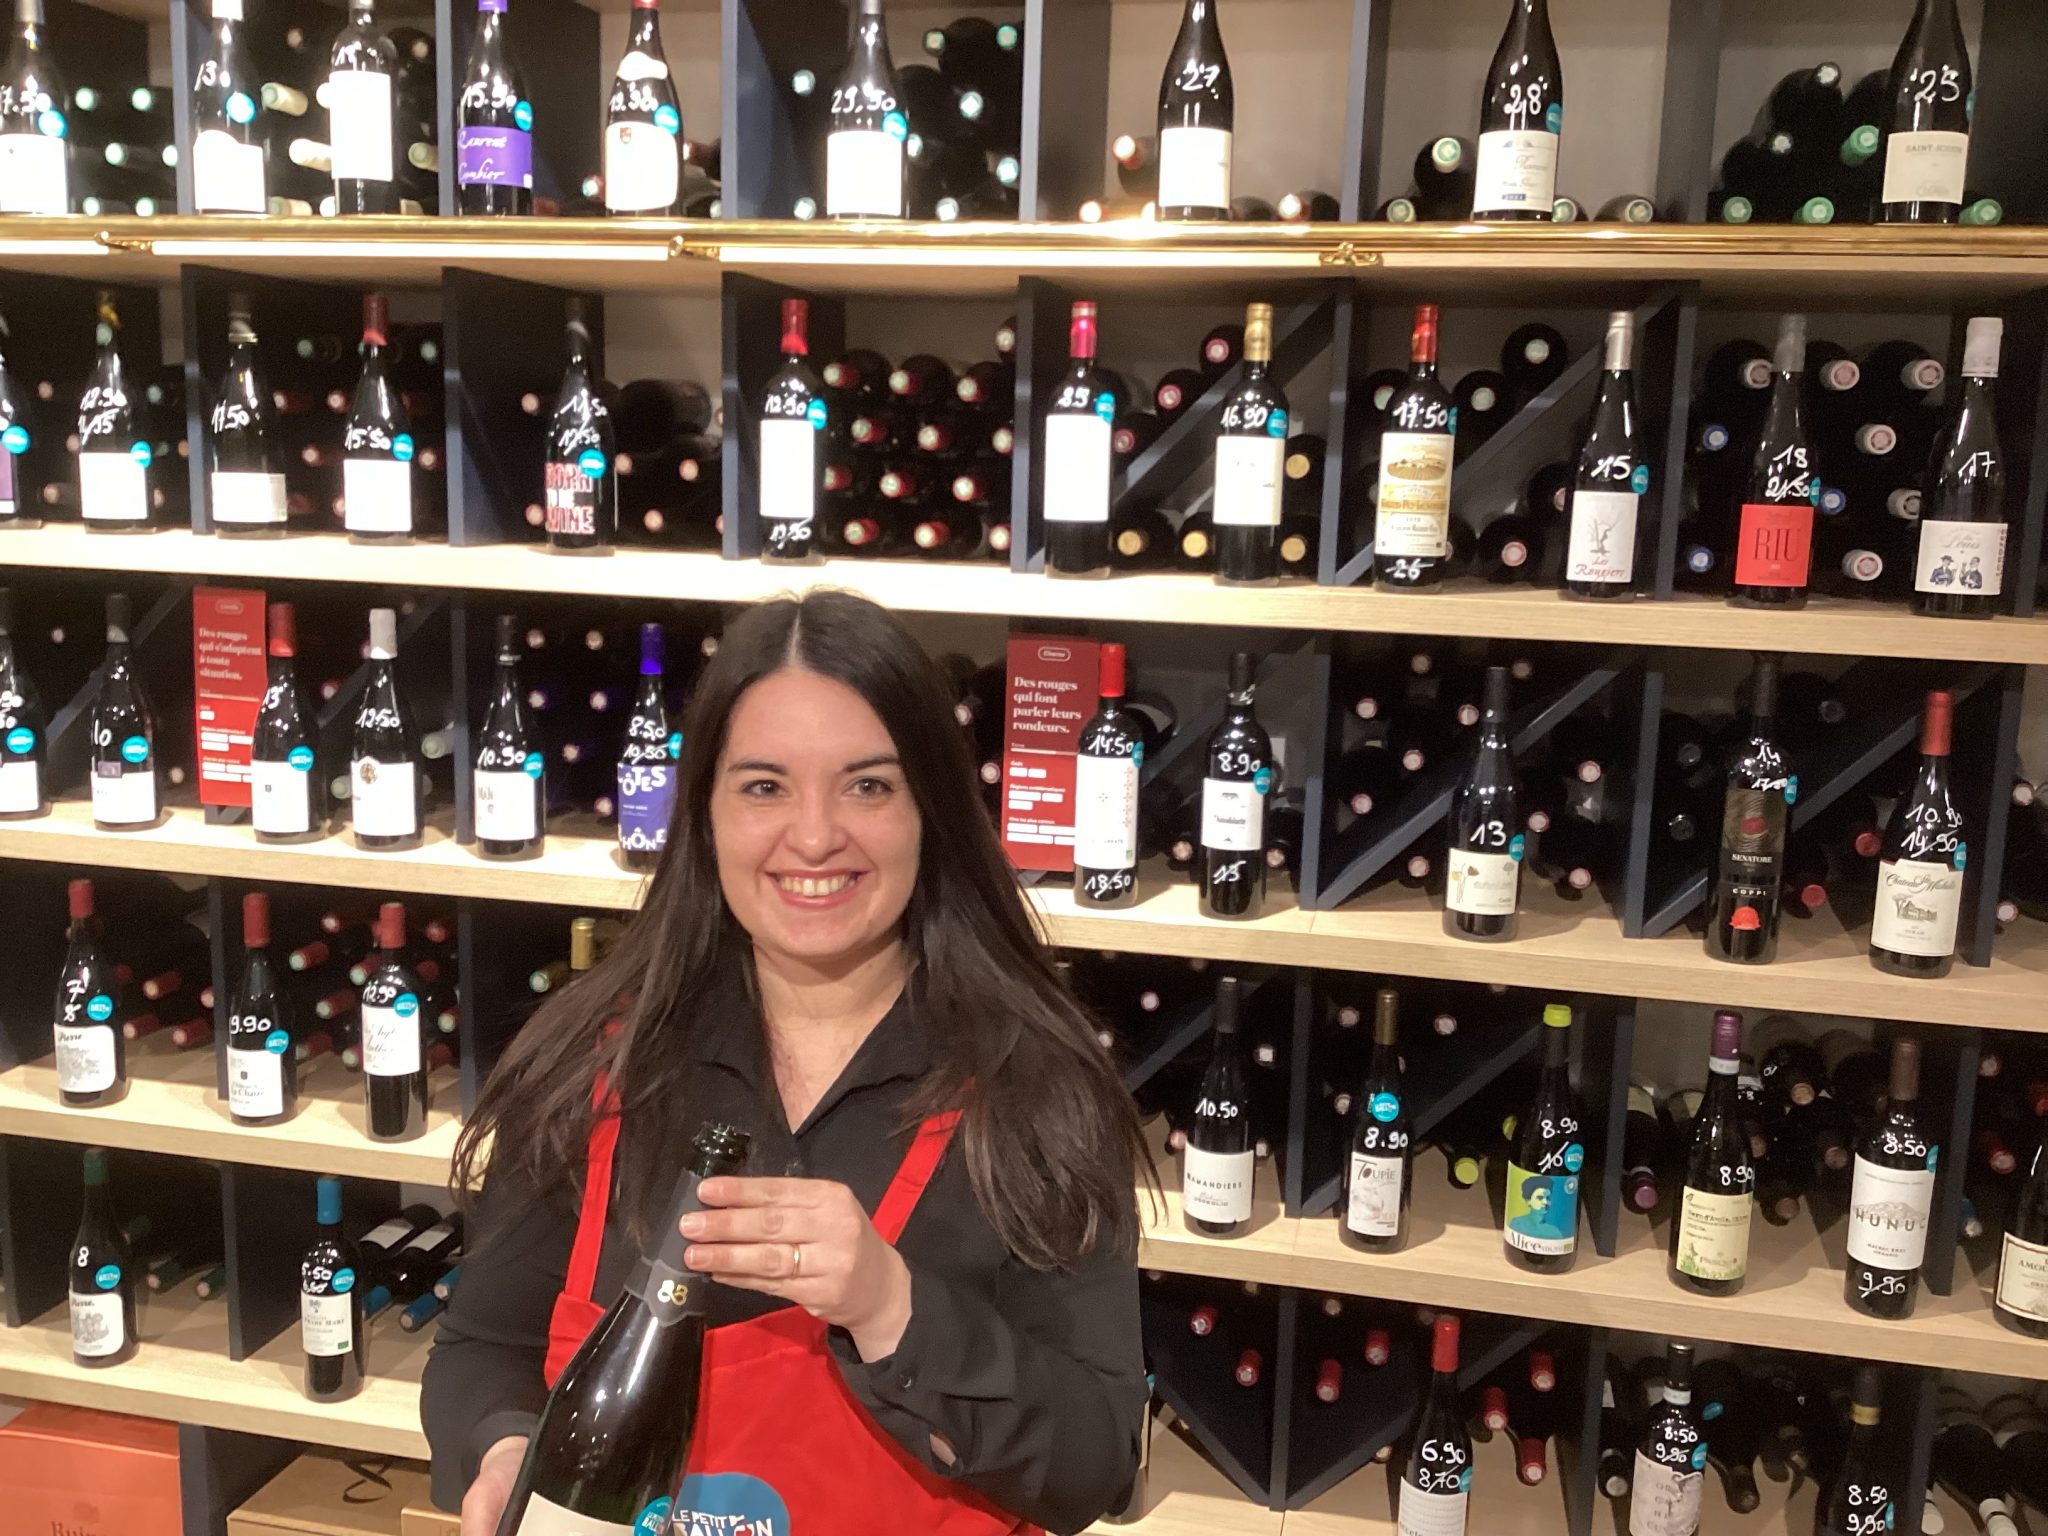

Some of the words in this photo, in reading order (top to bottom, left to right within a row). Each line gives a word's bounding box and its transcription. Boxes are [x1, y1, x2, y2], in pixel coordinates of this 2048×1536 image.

[1773, 445, 1808, 469] 18
[1958, 451, 1996, 478] 17
[1014, 677, 1041, 688] Des
[1042, 680, 1078, 692] rouges
[1013, 692, 1032, 704] qui
[1034, 692, 1057, 704] font
[1013, 706, 1049, 718] parler
[1051, 707, 1082, 719] leurs
[1012, 721, 1070, 733] rondeurs.
[1218, 752, 1260, 776] 8.90
[1469, 820, 1508, 847] 13
[1731, 853, 1773, 864] SENATORE
[230, 1014, 272, 1035] 9.90
[1195, 1097, 1239, 1118] 10.50
[1364, 1126, 1409, 1149] 8.90
[1541, 1117, 1578, 1141] 8.90
[1718, 1165, 1753, 1188] 8.90
[1511, 1231, 1542, 1253] Alice
[78, 1245, 90, 1268] 8
[1422, 1440, 1465, 1465] 6.90
[1848, 1485, 1887, 1505] 8.50
[672, 1509, 690, 1522] LE
[692, 1511, 727, 1528] PETIT
